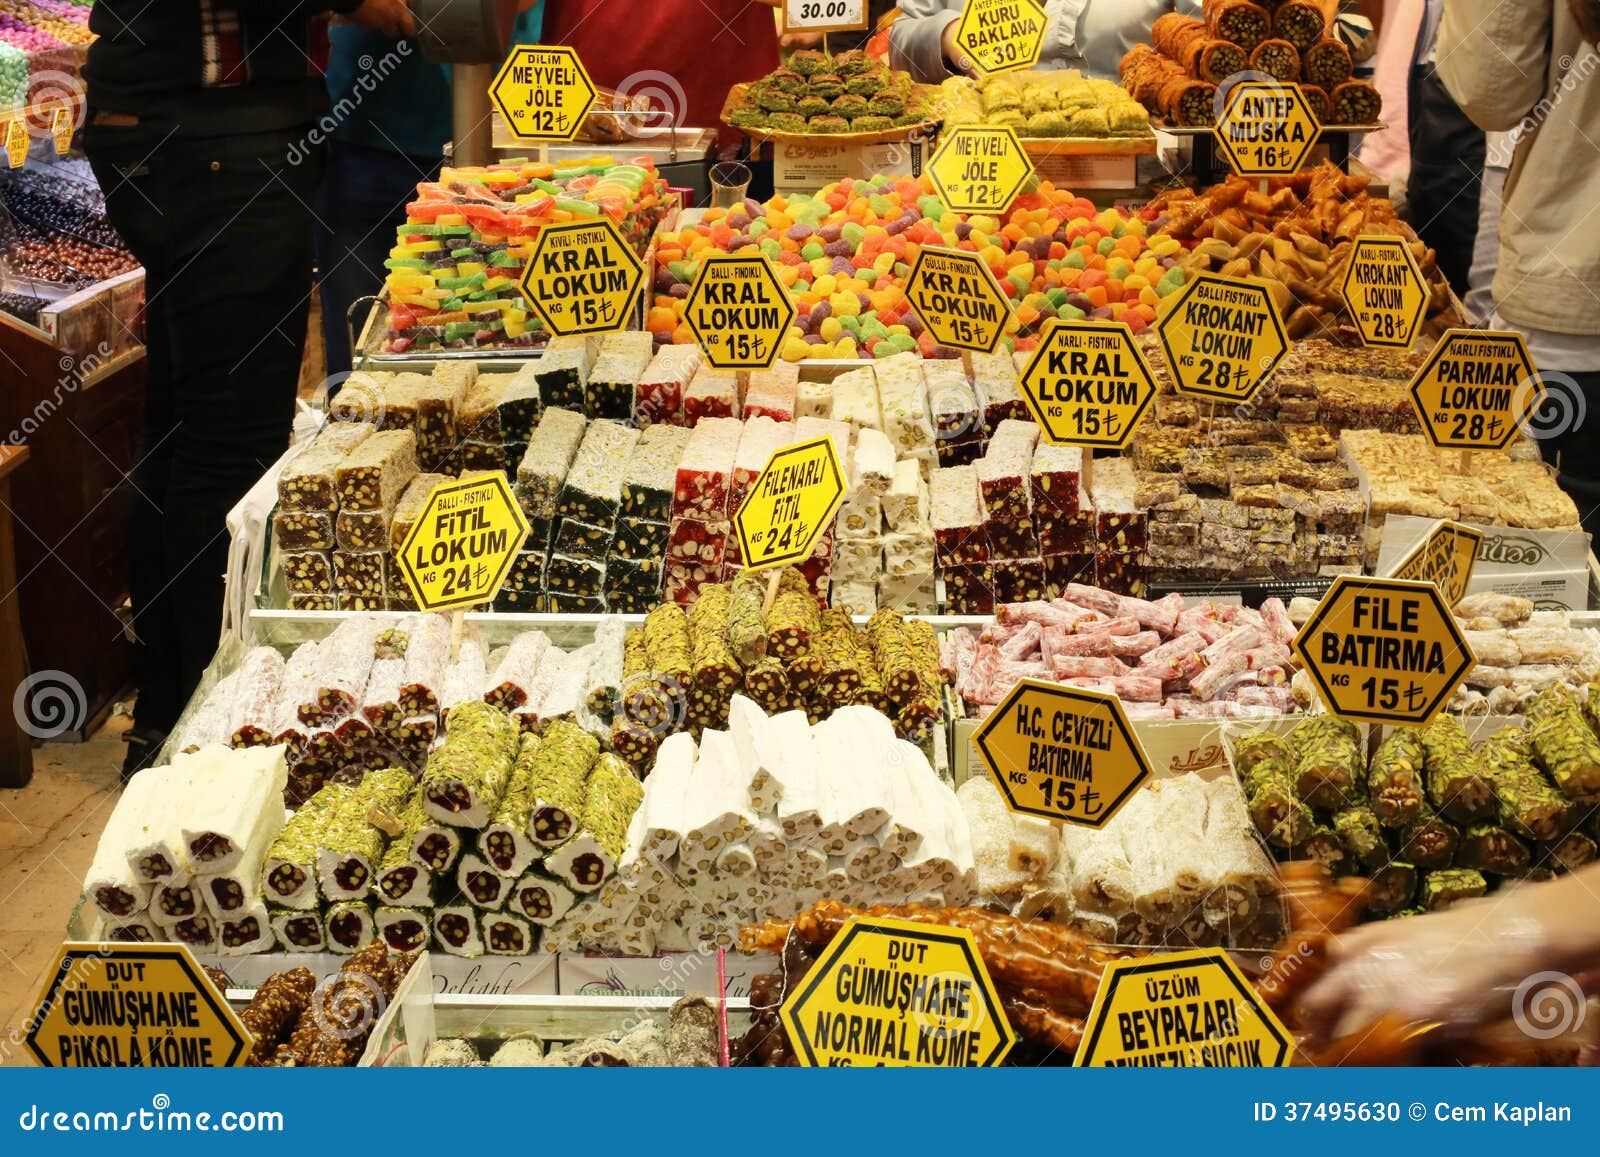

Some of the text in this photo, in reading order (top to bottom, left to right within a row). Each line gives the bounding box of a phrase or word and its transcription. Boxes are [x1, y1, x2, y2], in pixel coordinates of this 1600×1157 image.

[800, 2, 846, 19] 30.00
[978, 4, 1020, 28] KURU
[967, 18, 1038, 49] BAKLAVA
[978, 48, 989, 58] KG
[526, 86, 563, 108] JÖLE
[1242, 96, 1295, 118] ANTEP
[513, 110, 525, 118] KG
[1229, 122, 1305, 143] MUSKA
[1236, 146, 1248, 155] KG
[961, 157, 998, 182] JÖLE
[948, 184, 958, 192] KG
[576, 230, 606, 246] FISTIKLI
[543, 246, 618, 275] KRAL
[925, 257, 946, 272] GÜLLÜ
[711, 268, 730, 280] BALLI
[734, 266, 762, 279] FINDIKLI
[1355, 263, 1408, 286] KROKANT
[538, 270, 628, 301] LOKUM
[704, 282, 771, 305] KRAL
[921, 270, 988, 300] KRAL
[549, 303, 563, 314] KG
[918, 292, 998, 323] LOKUM
[1198, 286, 1262, 308] BALLI FISTIKLI
[1364, 286, 1403, 310] LOKUM
[698, 308, 780, 330] LOKUM
[929, 314, 942, 325] KG
[1184, 301, 1268, 337] KROKANT
[1360, 312, 1370, 322] KG
[707, 334, 719, 345] KG
[1058, 335, 1082, 348] NARLI
[1088, 336, 1121, 350] FISTIKLI
[1192, 328, 1254, 362] LOKUM
[1450, 343, 1516, 358] NARLI FISTIKLI
[1048, 350, 1130, 378] KRAL
[1180, 354, 1194, 367] KG
[1437, 360, 1521, 386] PARMAK
[1039, 378, 1138, 406] LOKUM
[1440, 386, 1512, 412] LOKUM
[1047, 406, 1062, 418] KG
[1433, 412, 1448, 423] KG
[438, 496, 458, 512] BALLI
[464, 488, 494, 505] FISTIKLI
[416, 528, 508, 570] LOKUM
[750, 531, 763, 544] KG
[422, 571, 436, 584] KG
[1321, 631, 1446, 675] BATIRMA
[1331, 674, 1350, 687] KG
[1016, 704, 1046, 738] H.C.
[1028, 741, 1092, 784] BATIRMA
[1009, 770, 1028, 785] KG
[888, 939, 929, 964] DUT
[106, 962, 146, 982] DUT
[836, 957, 972, 1020] GÜMÜŞHANE
[1145, 974, 1201, 1002] ÜZÜM
[62, 982, 200, 1035] GÜMÜŞHANE
[1118, 998, 1240, 1052] BEYPAZARI
[149, 1028, 214, 1067] KÖME
[814, 1010, 982, 1066] NORMAL KÖME
